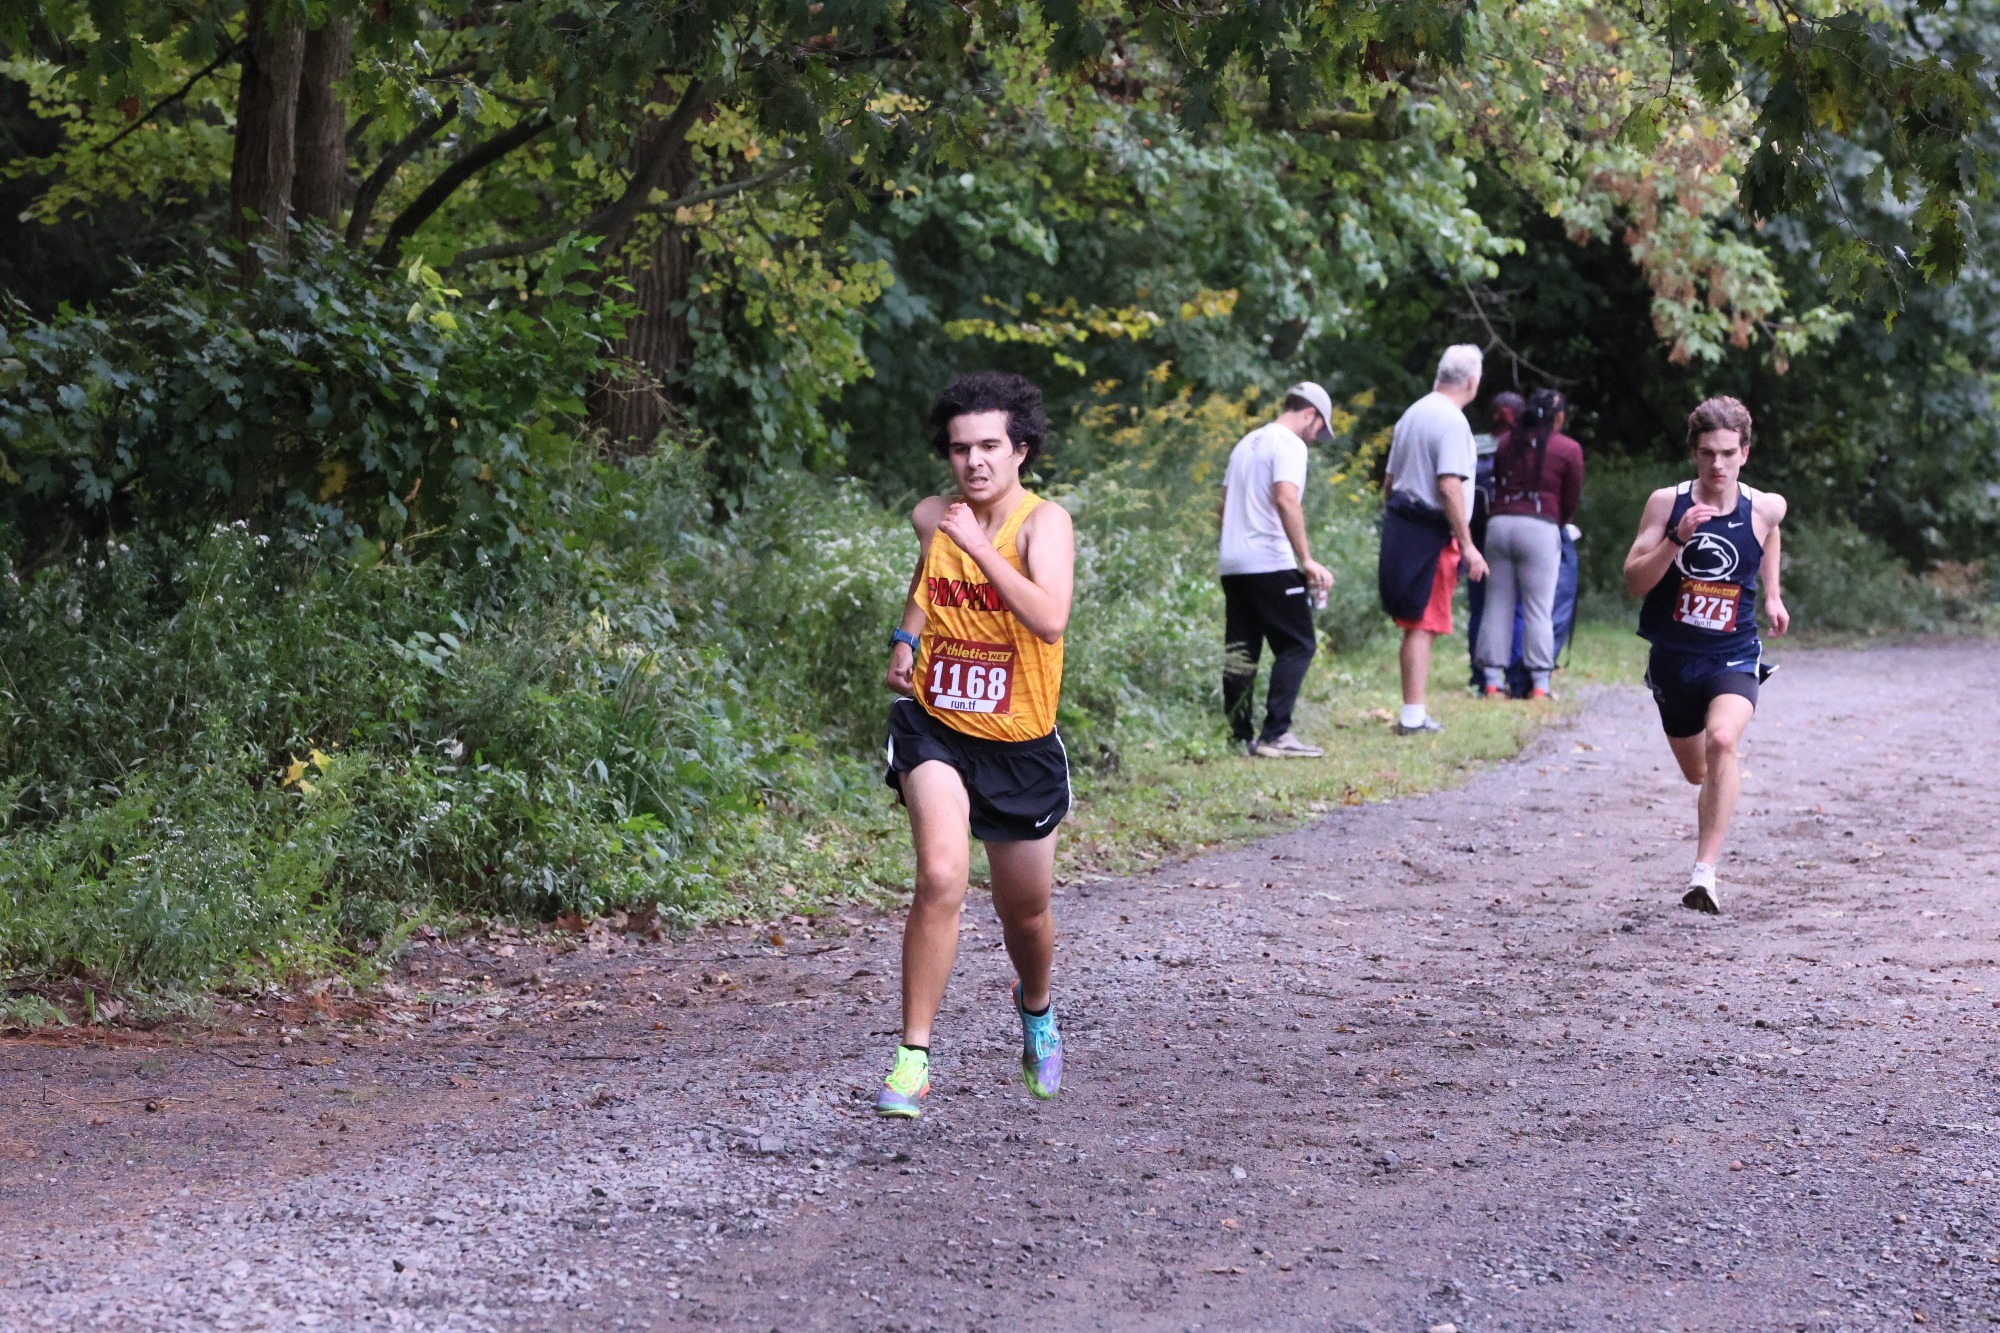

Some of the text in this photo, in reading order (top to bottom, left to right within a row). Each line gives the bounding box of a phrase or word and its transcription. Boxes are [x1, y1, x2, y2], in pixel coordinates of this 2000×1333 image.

[1680, 593, 1735, 622] 1275
[929, 660, 1007, 700] 1168
[950, 700, 977, 711] run.tf
